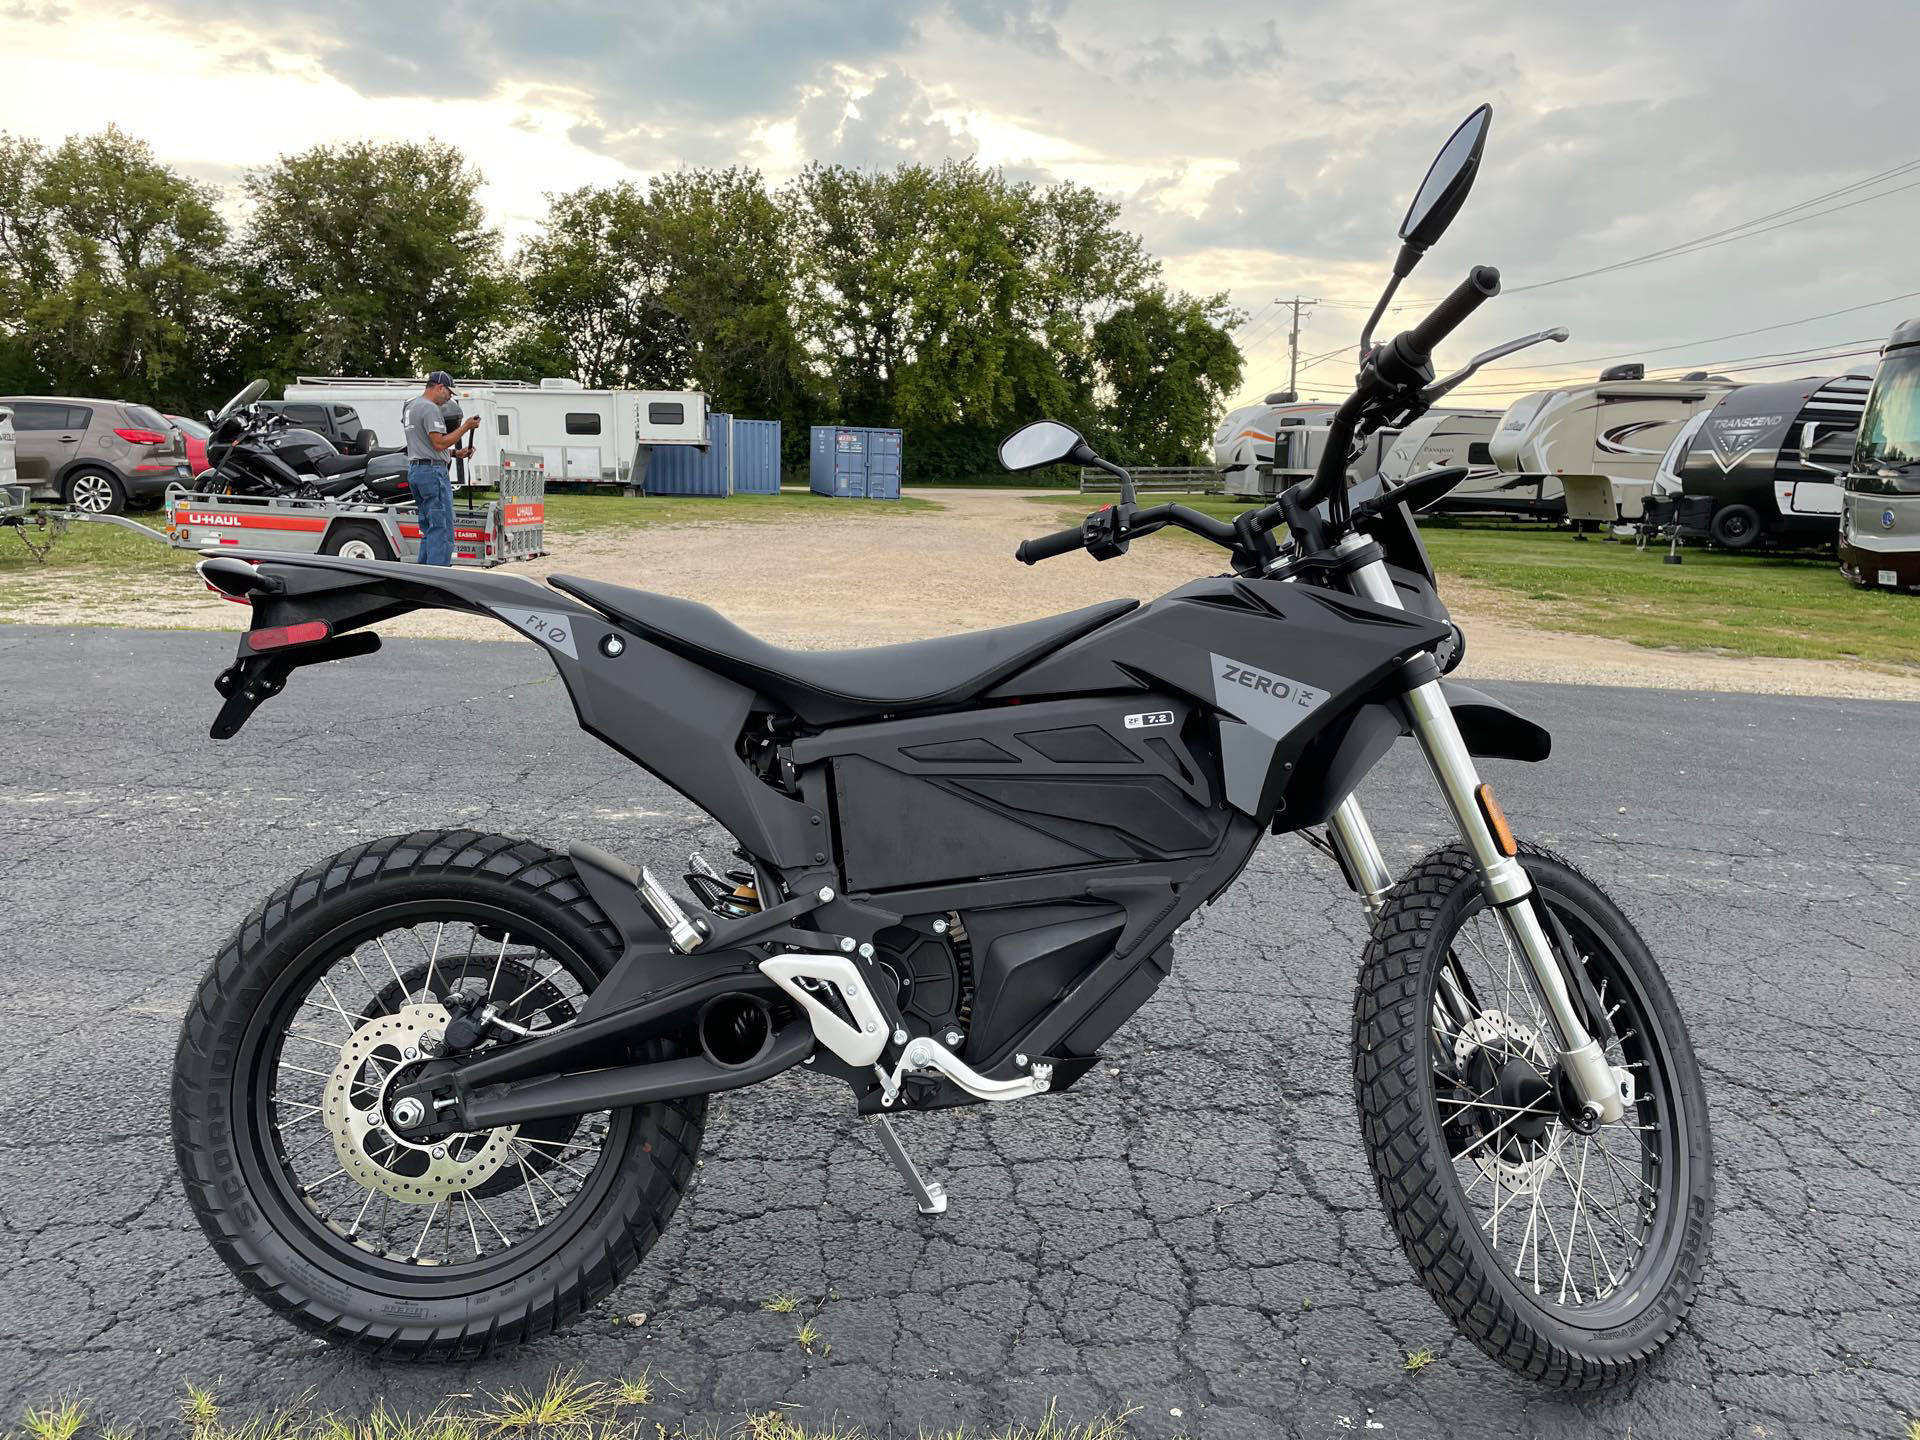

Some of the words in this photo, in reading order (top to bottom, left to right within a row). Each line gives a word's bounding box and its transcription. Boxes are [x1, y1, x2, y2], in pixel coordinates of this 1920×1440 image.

[1713, 416, 1782, 428] TRANSCEND
[189, 514, 241, 526] U-HAUL
[1221, 664, 1290, 699] ZERO
[1298, 690, 1314, 708] FX
[1148, 714, 1167, 723] 7.2
[1657, 1195, 1705, 1319] PIRELLI
